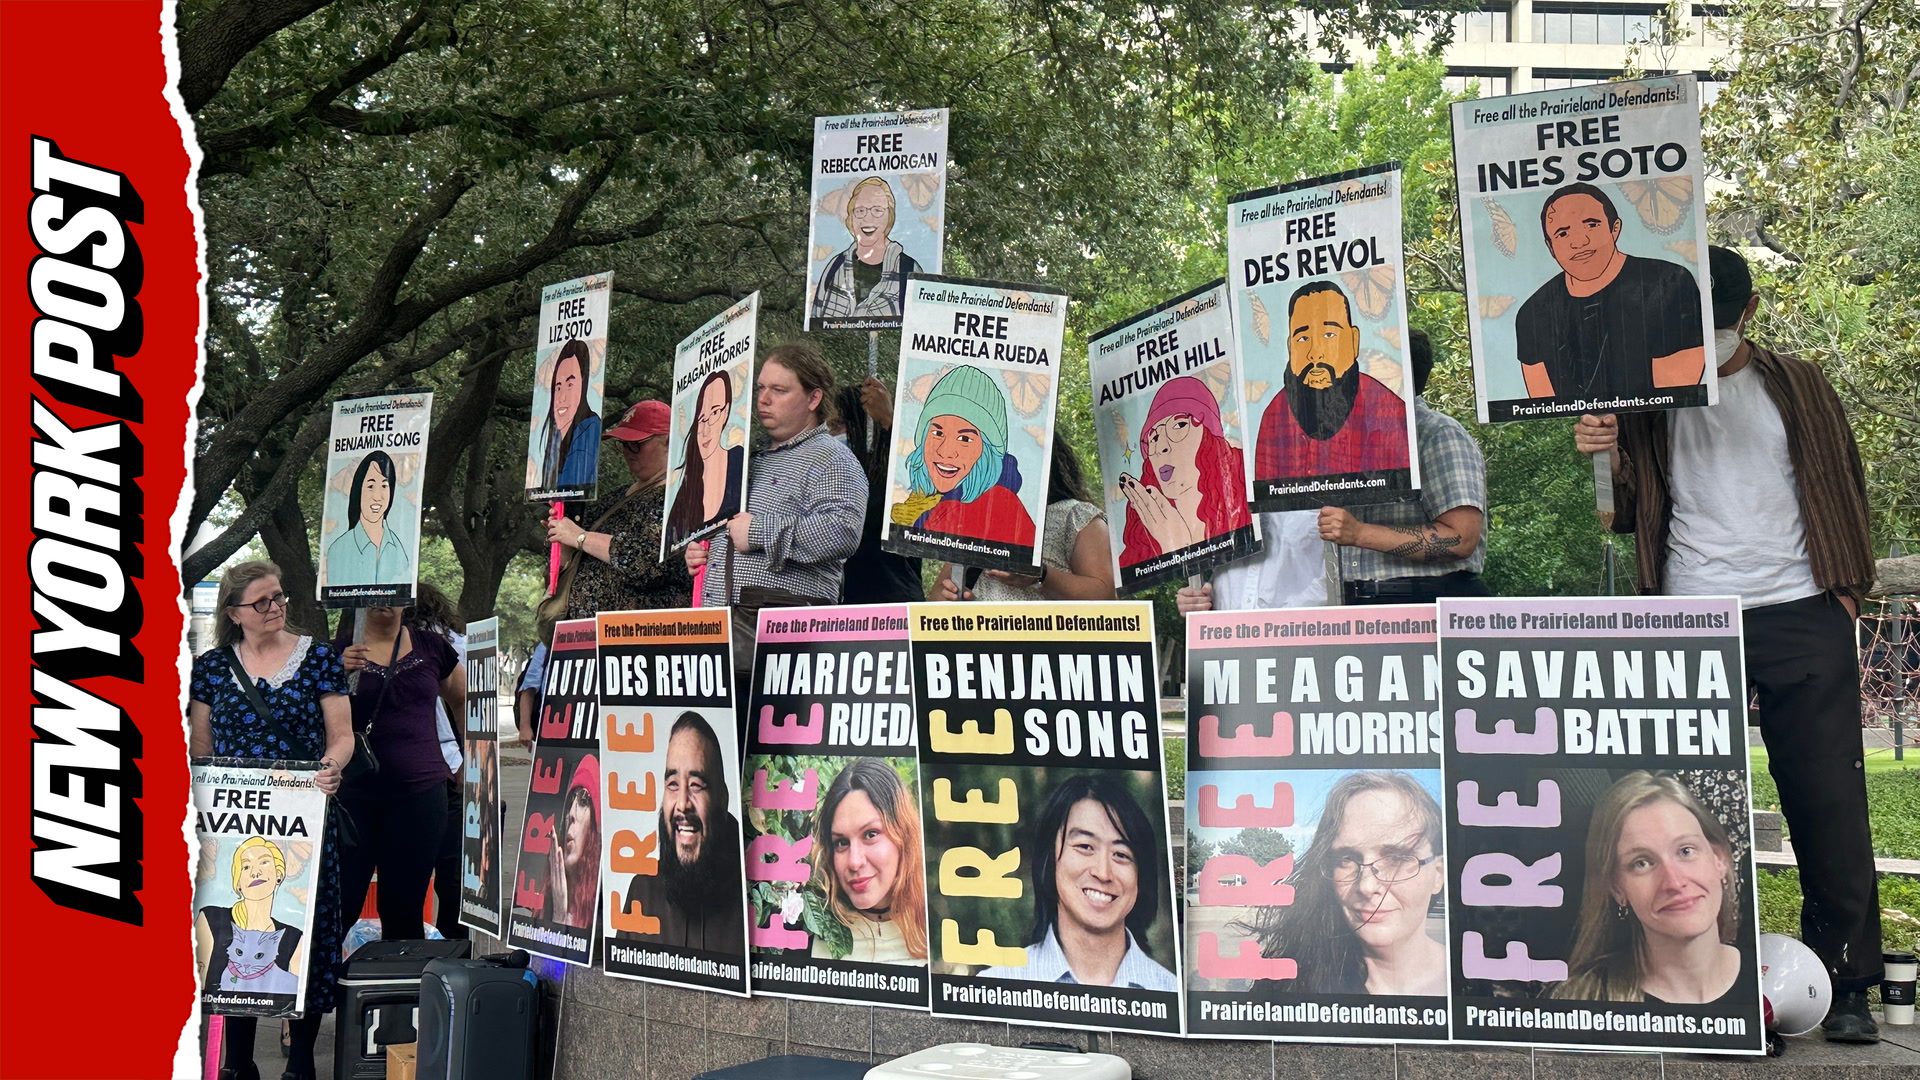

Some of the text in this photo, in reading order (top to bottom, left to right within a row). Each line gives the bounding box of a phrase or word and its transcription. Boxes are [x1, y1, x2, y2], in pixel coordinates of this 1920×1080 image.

[1474, 84, 1681, 124] Free all the Prairieland Defendants!
[824, 120, 839, 130] Free
[840, 119, 848, 129] all
[849, 118, 860, 128] the
[861, 115, 898, 128] Prairieland
[1536, 114, 1621, 151] FREE
[856, 133, 903, 154] FREE
[821, 152, 938, 174] REBECCA MORGAN
[1477, 142, 1688, 193] INES SOTO
[1241, 179, 1387, 223] Free all the Prairieland Defendants!
[1286, 212, 1336, 245] FREE
[1244, 236, 1385, 287] DES REVOL
[558, 297, 586, 321] FREE
[918, 287, 1054, 314] Free all the Prairieland Defendants!
[549, 318, 593, 344] LIZ SOTO
[953, 311, 1009, 341] FREE
[1100, 293, 1217, 356] Free all the Prairieland Defendants!
[699, 330, 725, 362] FREE
[911, 333, 1050, 367] MARICELA RUEDA
[1136, 329, 1179, 365] FREE
[675, 335, 750, 395] MEAGAN MORRIS
[1099, 337, 1226, 406] AUTUMN HILL
[360, 413, 394, 433] FREE
[1512, 394, 1674, 417] PrairielandDefendants.com
[334, 431, 420, 452] BENJAMIN SONG
[1269, 477, 1386, 496] PrairielandDefendants.com
[903, 530, 1011, 558] PrairielandDefendants.com
[1134, 537, 1234, 577] PrairielandDefendants.com
[604, 623, 621, 638] Free
[621, 623, 633, 637] the
[635, 622, 677, 637] Prairieland
[677, 620, 722, 636] Defendants!
[766, 619, 788, 634] Free
[790, 618, 807, 633] the
[809, 616, 869, 633] Prairieland
[920, 615, 1141, 632] Free the Prairieland Defendants!
[1200, 624, 1233, 640] Free
[1235, 623, 1261, 639] the
[1264, 620, 1351, 638] Prairieland
[1449, 611, 1730, 630] Free the Prairieland Defendants!
[547, 658, 598, 696] AUTU
[605, 653, 727, 698] DES REVOL
[924, 653, 1145, 703] BENJAMIN
[1456, 649, 1731, 699] SAVANNA
[1023, 707, 1150, 760] SONG
[1563, 708, 1732, 756] BATTEN
[195, 772, 207, 783] all
[220, 773, 266, 786] Prairieland
[266, 776, 316, 789] Defendants!
[212, 788, 272, 810] FREE
[516, 703, 572, 910] FREE
[606, 712, 661, 935] FREE
[746, 703, 824, 950] FREE
[928, 707, 1029, 968] FREE
[1198, 711, 1298, 981] FREE
[1455, 706, 1569, 983] FREE
[610, 944, 740, 980] PrairielandDefendants.com
[942, 982, 1168, 1020] PrairielandDefendants.com
[1466, 1005, 1746, 1036] PrairielandDefendants.com
